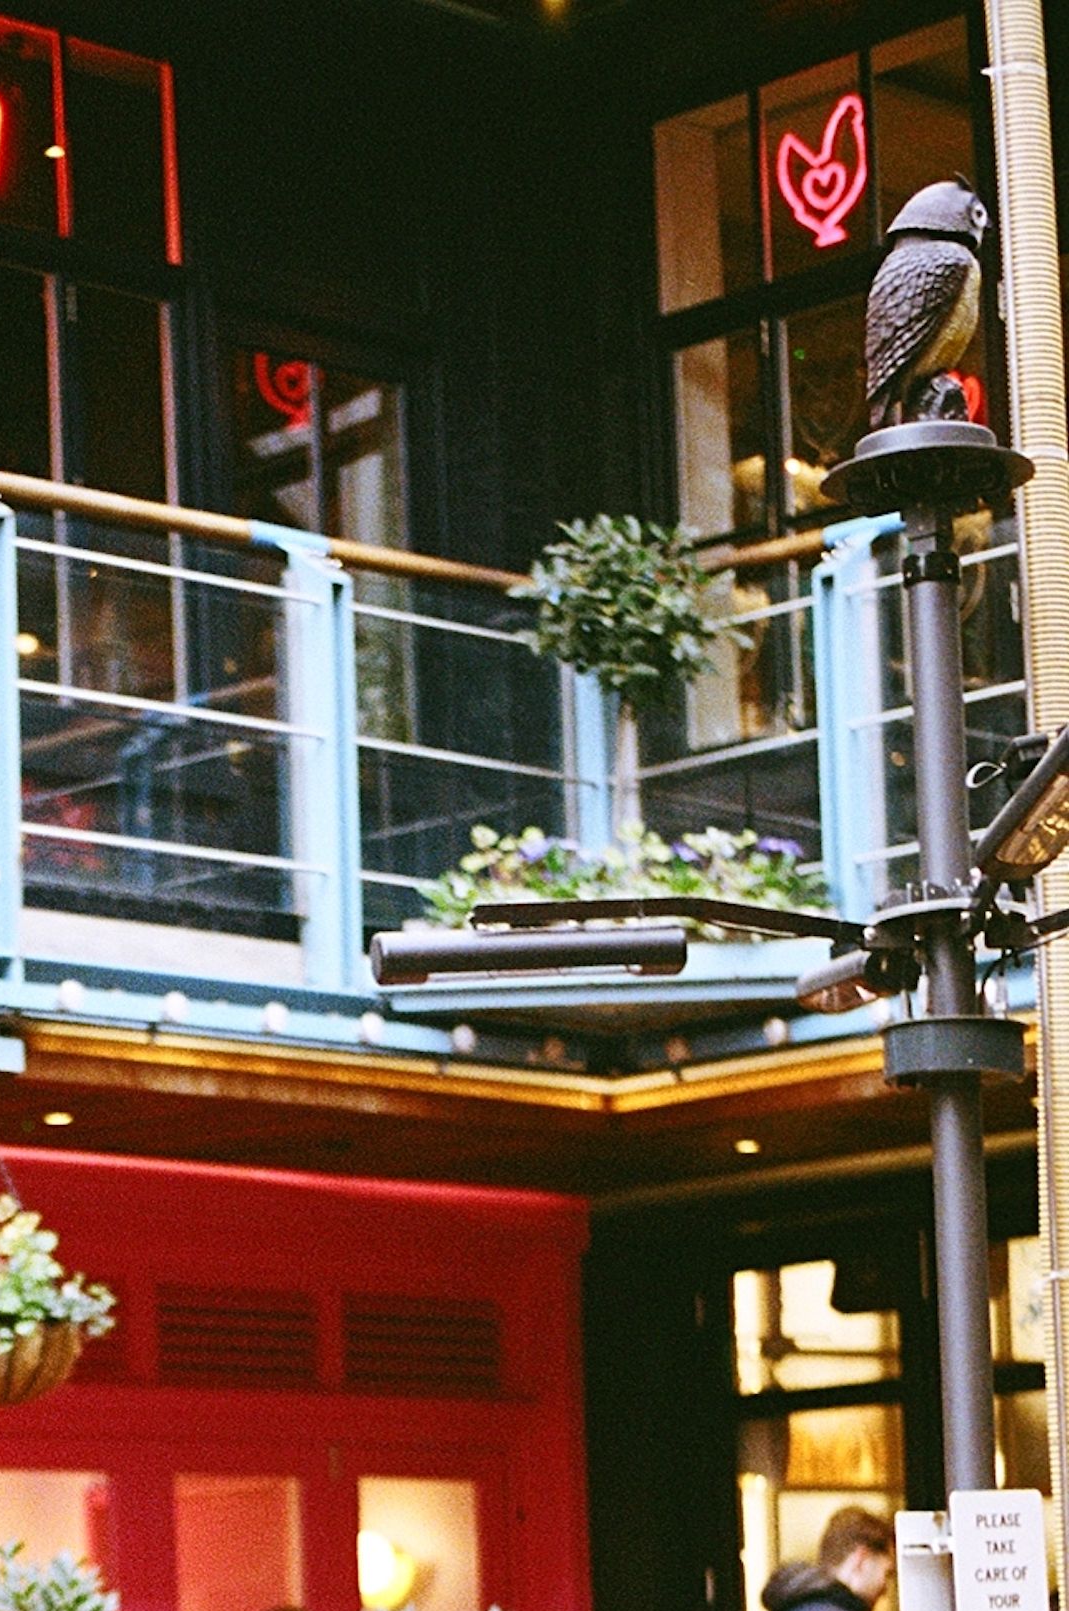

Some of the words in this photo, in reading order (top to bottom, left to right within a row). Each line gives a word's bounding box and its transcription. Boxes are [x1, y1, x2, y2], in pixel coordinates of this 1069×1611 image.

[975, 1512, 1021, 1528] PLEASE
[985, 1540, 1016, 1555] TAKE
[974, 1567, 1008, 1581] CARE
[1012, 1566, 1029, 1580] OF
[988, 1594, 1021, 1609] YOUR
